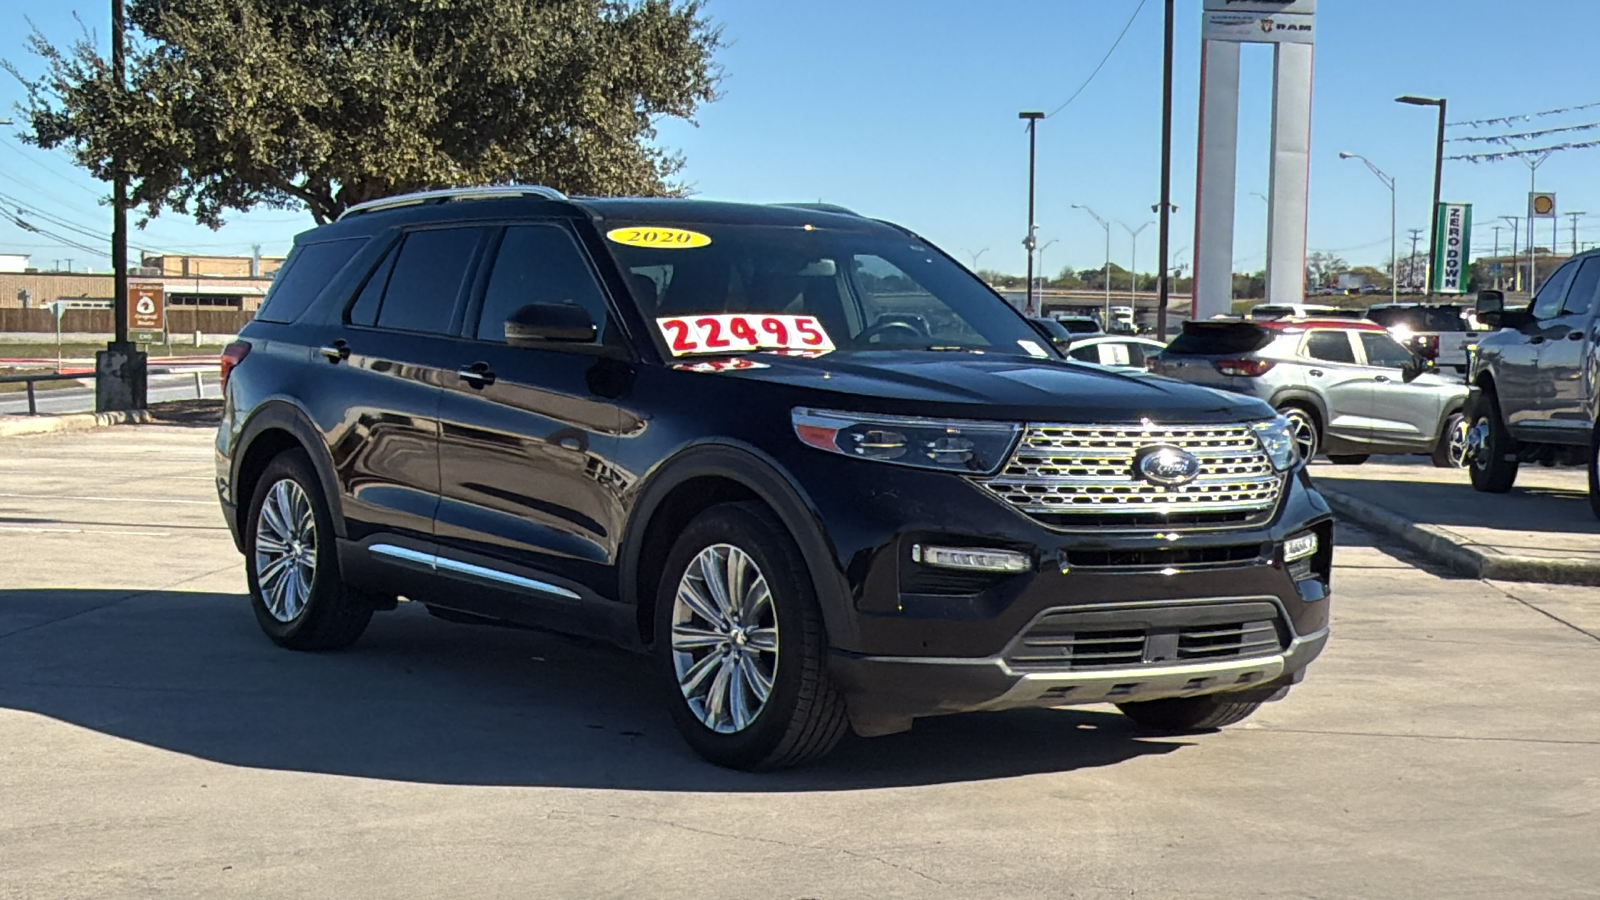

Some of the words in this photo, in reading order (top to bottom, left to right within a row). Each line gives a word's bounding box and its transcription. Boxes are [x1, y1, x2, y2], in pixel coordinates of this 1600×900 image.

[1276, 23, 1312, 31] RAM
[627, 231, 691, 243] 2020
[1448, 208, 1460, 246] ZERO
[1445, 250, 1458, 287] DOWN
[663, 317, 823, 351] 22495
